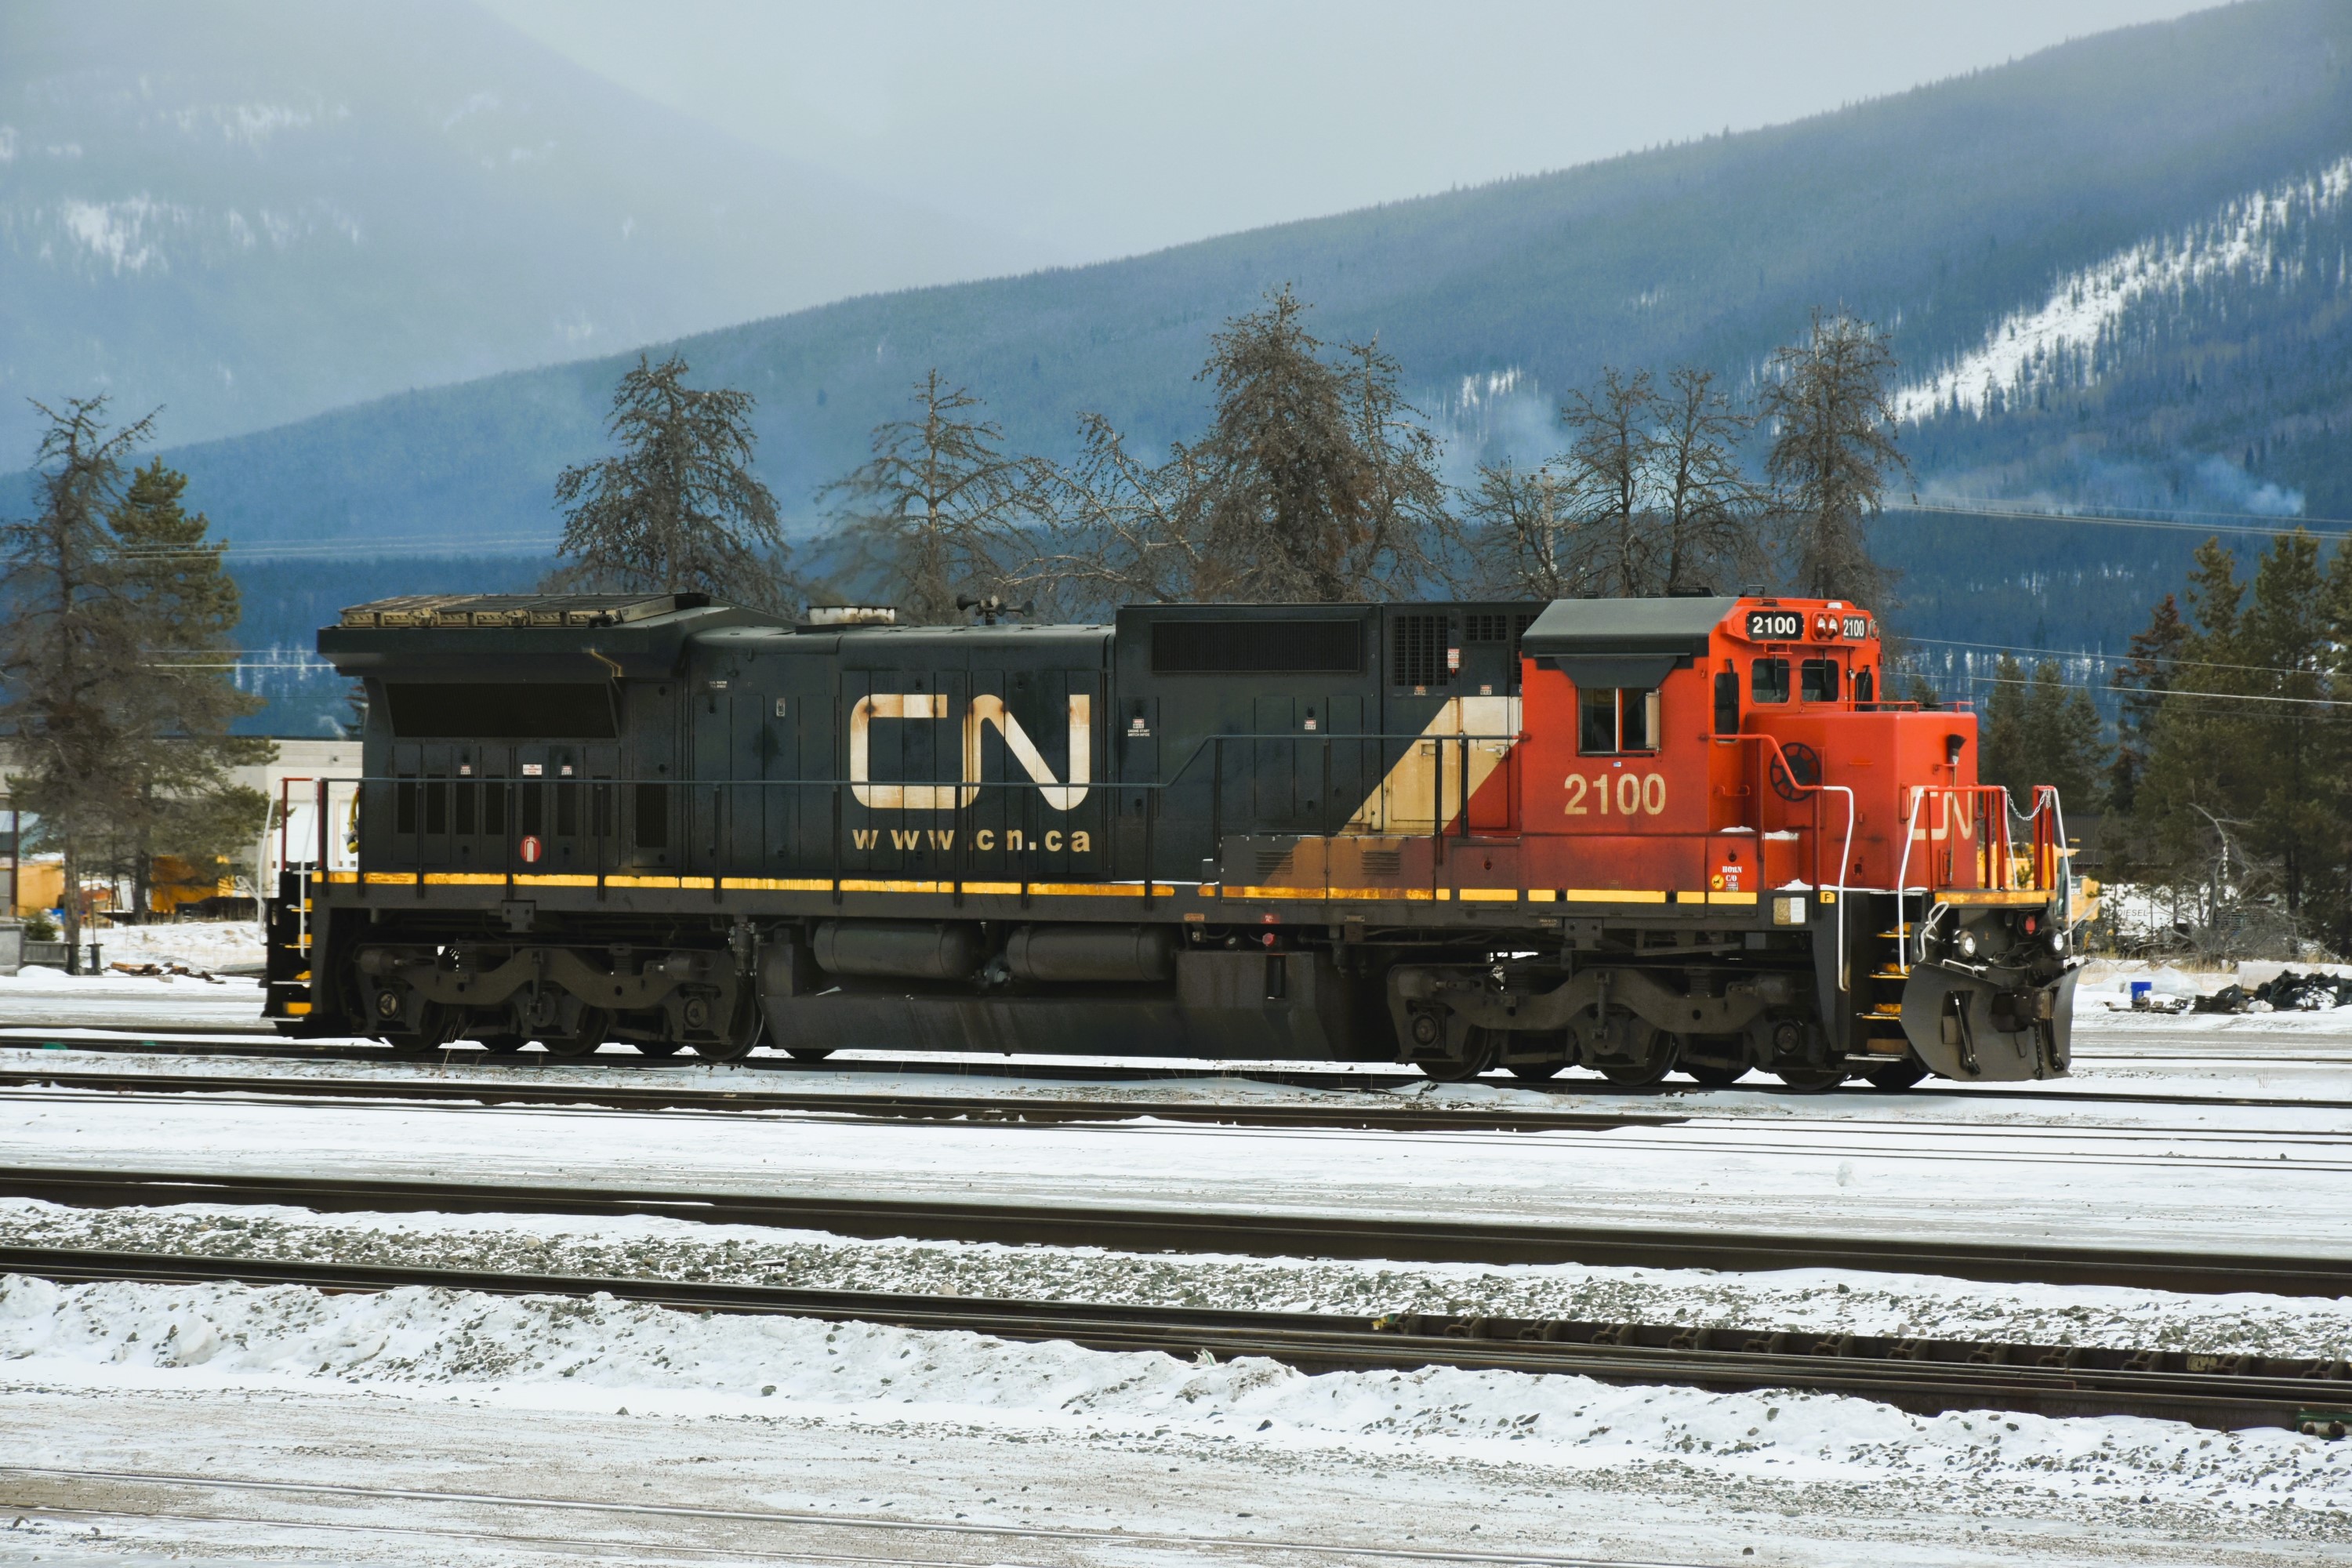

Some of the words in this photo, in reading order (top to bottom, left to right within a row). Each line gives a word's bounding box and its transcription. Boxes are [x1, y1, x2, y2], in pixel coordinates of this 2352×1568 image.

[1752, 616, 1796, 634] 2100
[1843, 619, 1865, 637] 2100
[850, 694, 1091, 811] CN
[1564, 773, 1666, 815] 2100
[1907, 785, 1973, 840] CN
[1824, 893, 1831, 902] F
